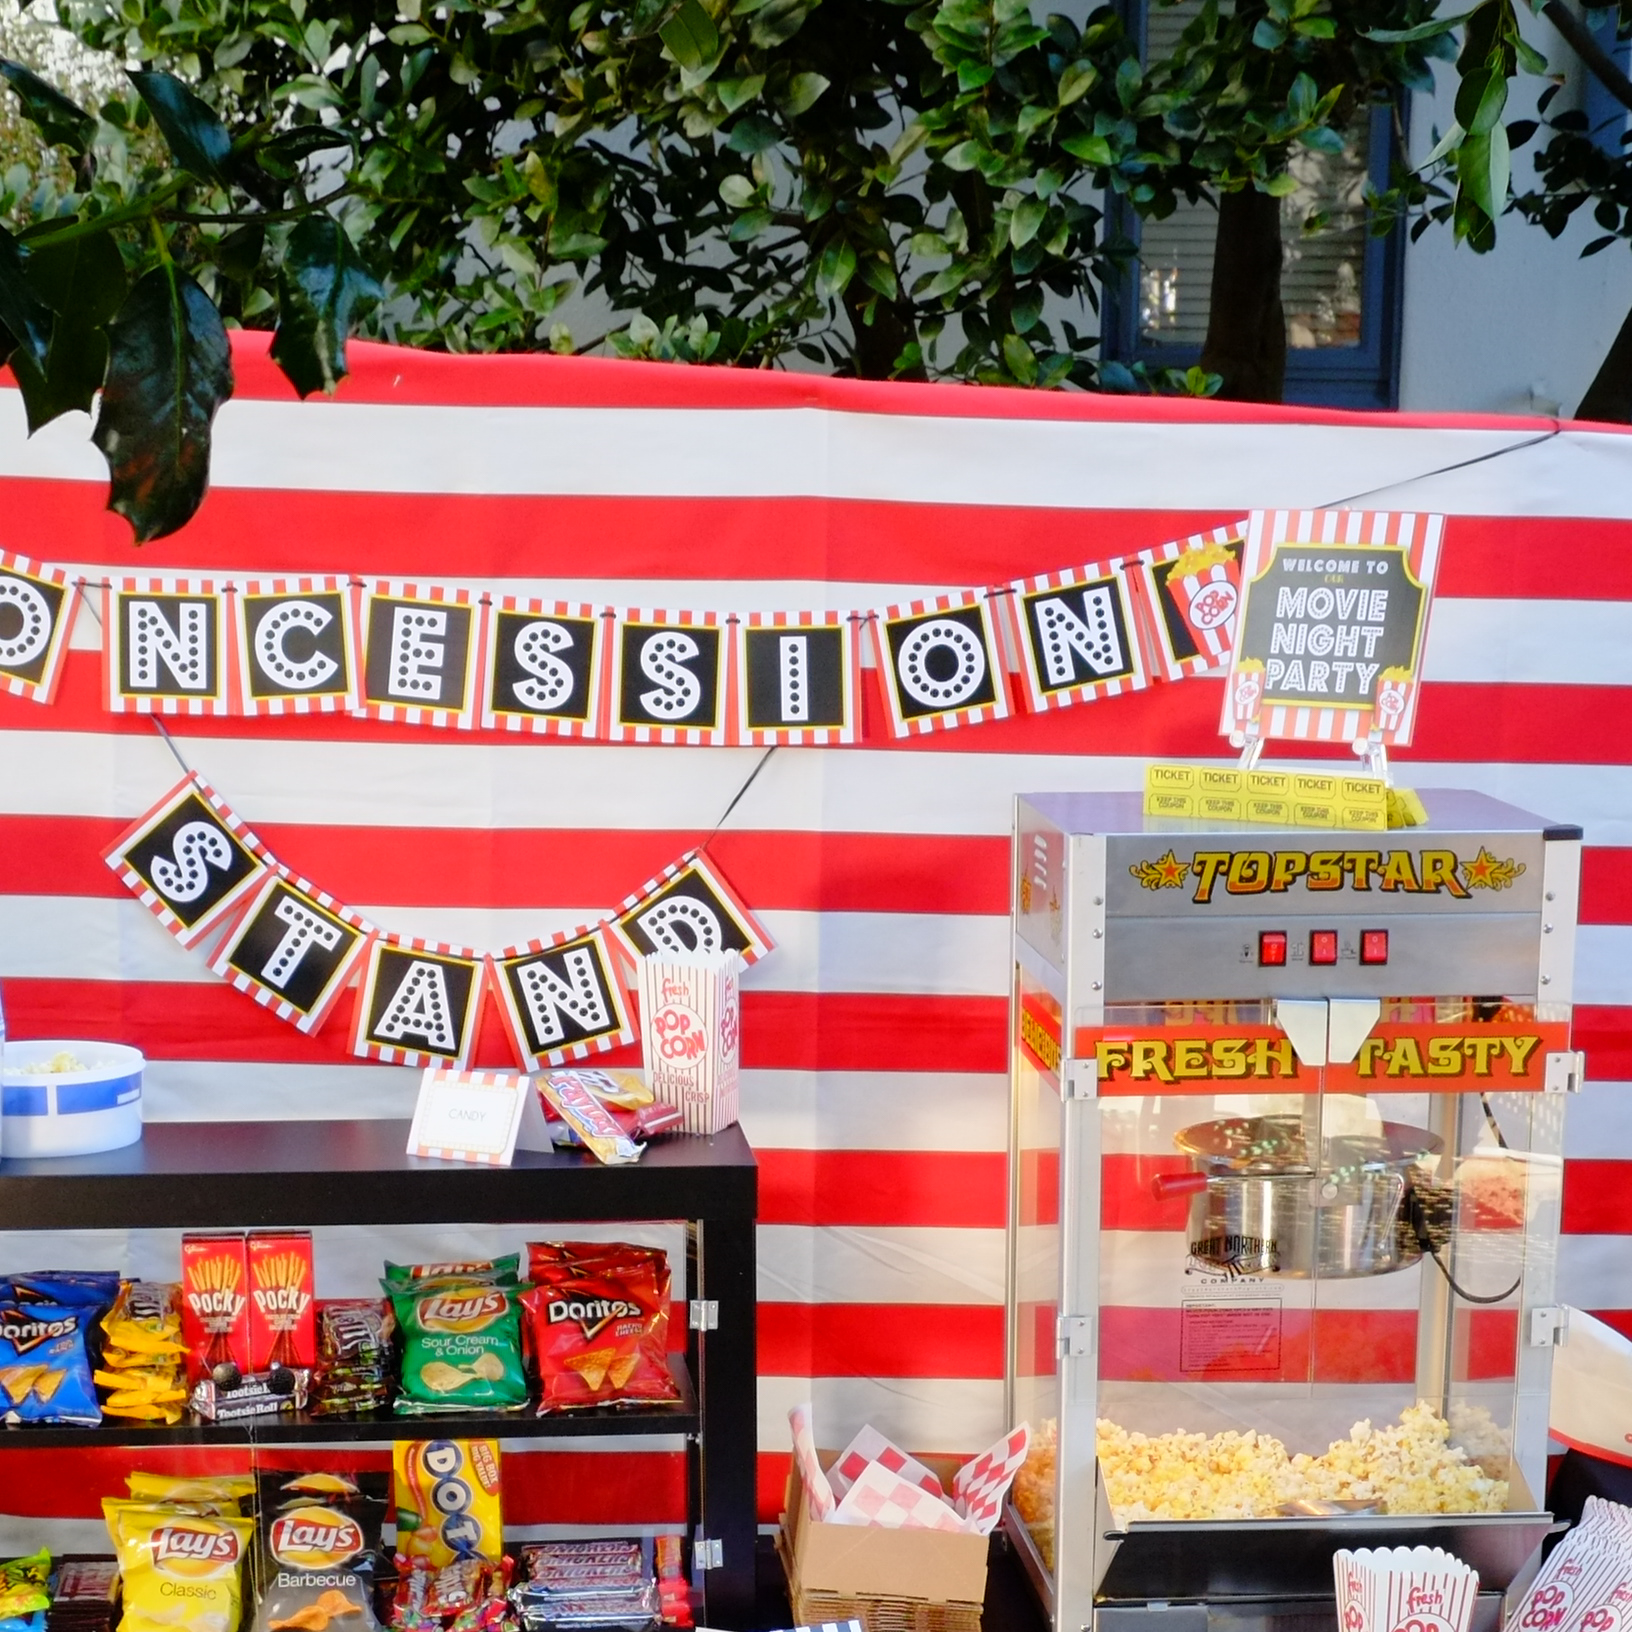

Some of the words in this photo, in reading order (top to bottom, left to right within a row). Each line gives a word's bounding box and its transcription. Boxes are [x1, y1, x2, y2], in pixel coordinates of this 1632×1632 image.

[1282, 558, 1360, 574] WELCOME
[1367, 560, 1389, 575] TO
[1275, 586, 1389, 622] MOVIE
[1270, 622, 1384, 658] NIGHT
[1265, 658, 1380, 695] PARTY
[1153, 769, 1190, 781] TICKET
[1203, 772, 1239, 785] TICKET
[1250, 775, 1286, 788] TICKET
[1297, 777, 1333, 791] TICKET
[1345, 782, 1381, 795] TICKET
[1192, 850, 1474, 903] TOPSTAR
[661, 978, 689, 1004] fresh
[654, 1009, 690, 1039] POP
[660, 1030, 705, 1060] CORN
[1096, 1037, 1300, 1083] FRESH
[1352, 1036, 1540, 1077] TASTY
[653, 1072, 694, 1087] DELICIOUS
[685, 1091, 710, 1103] CRISP
[448, 1108, 486, 1123] CANDY
[549, 1299, 641, 1323] Doritos
[421, 1337, 452, 1349] Sour
[455, 1334, 499, 1346] Cream
[435, 1347, 444, 1356] &
[447, 1344, 485, 1356] Onion
[425, 1446, 481, 1557] DOT
[160, 1582, 217, 1600] Classic
[278, 1572, 356, 1588] Barbecue
[1406, 1586, 1443, 1613] fresh
[1532, 1585, 1566, 1610] POP
[1521, 1607, 1567, 1632] CORN
[1581, 1608, 1615, 1632] POP
